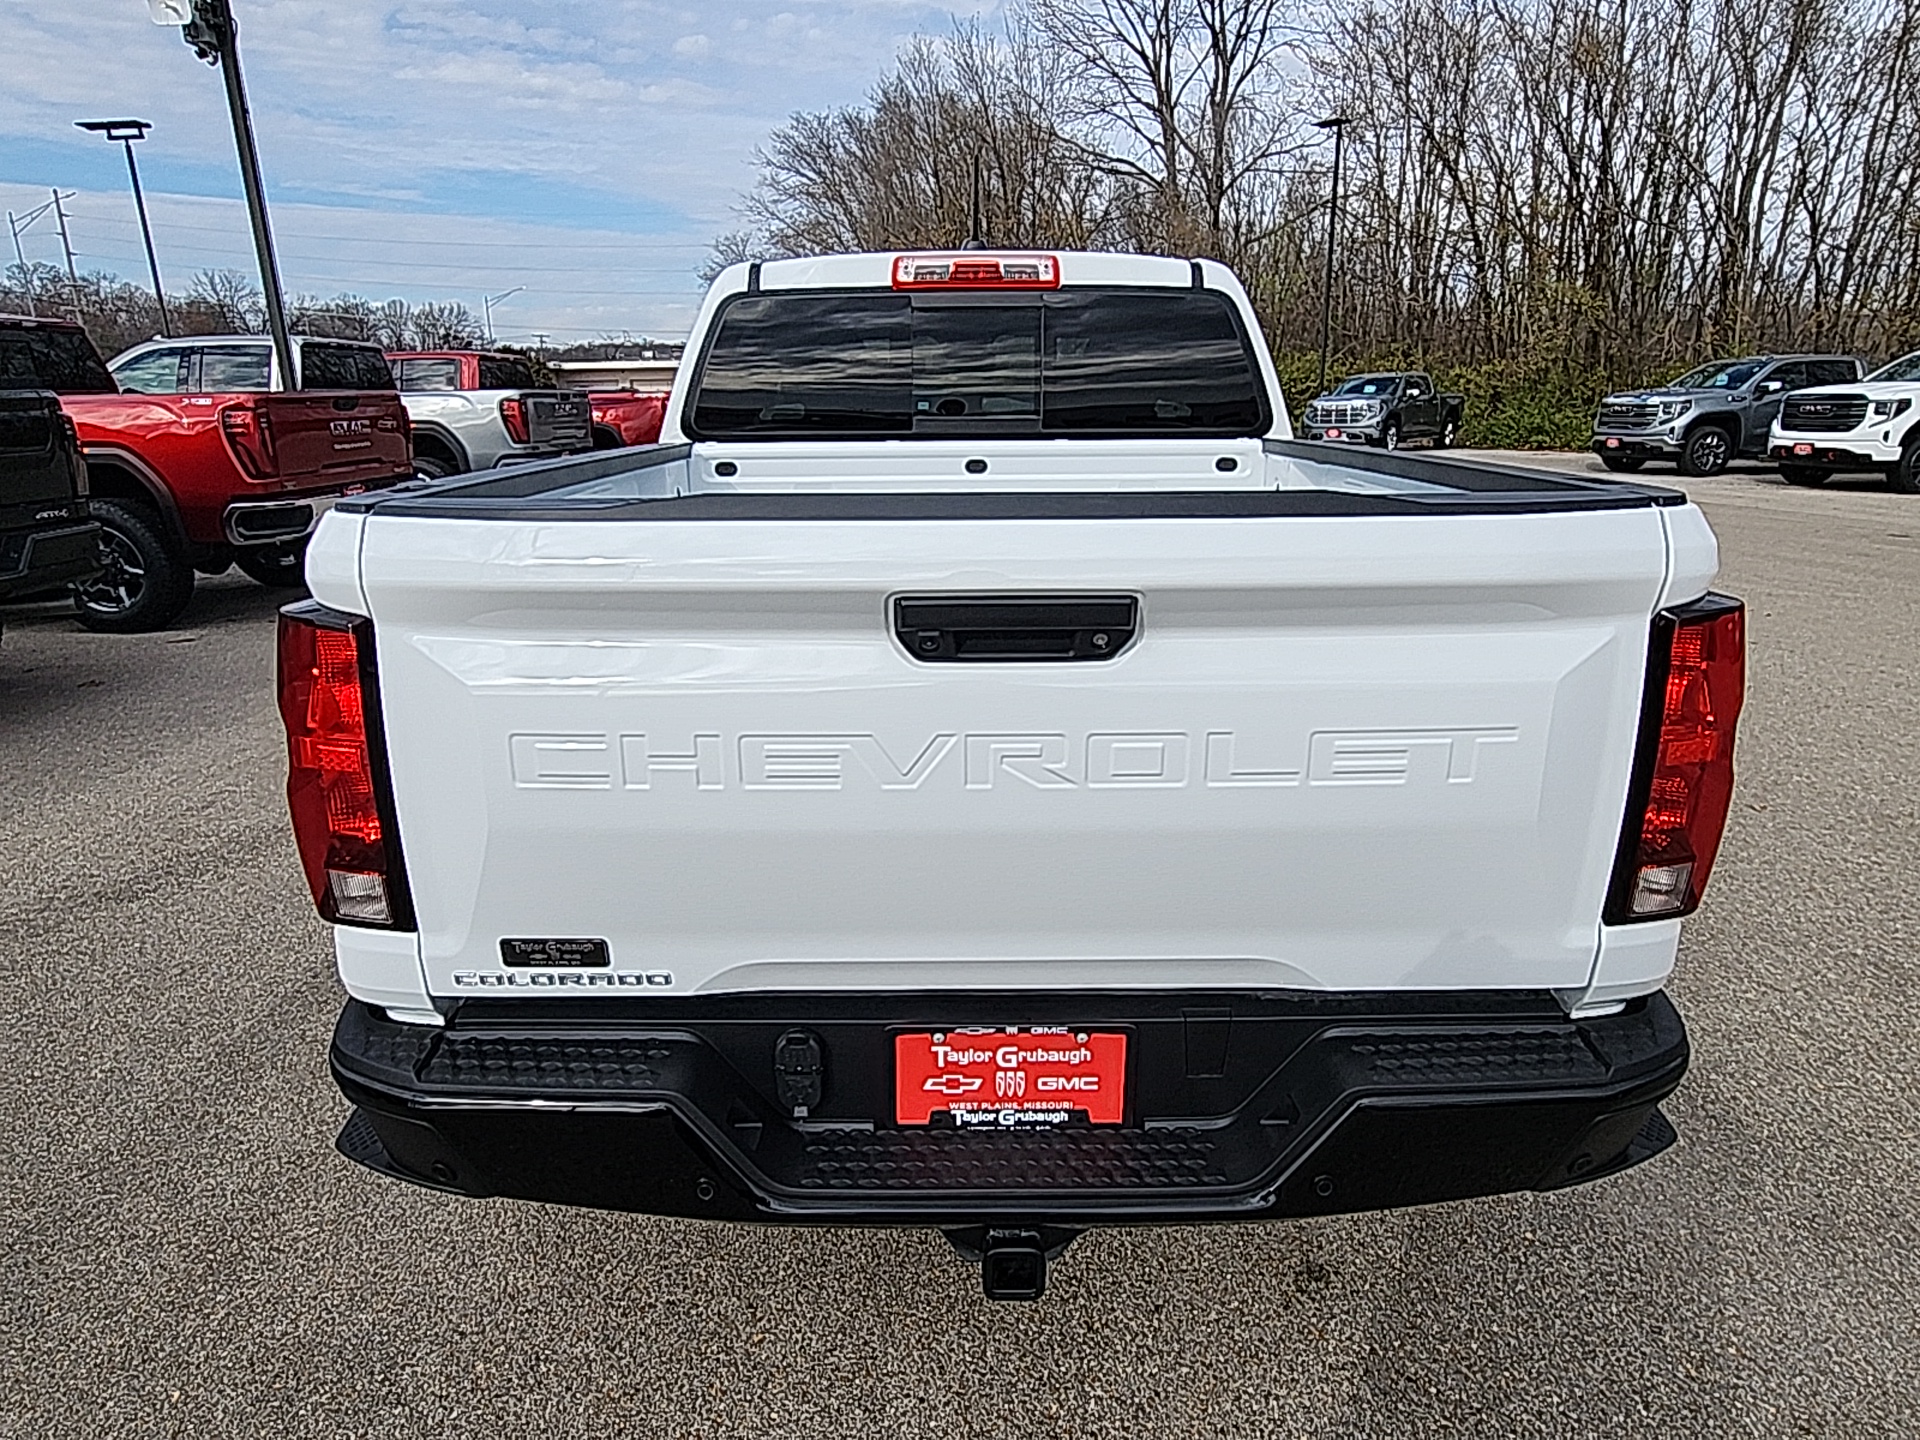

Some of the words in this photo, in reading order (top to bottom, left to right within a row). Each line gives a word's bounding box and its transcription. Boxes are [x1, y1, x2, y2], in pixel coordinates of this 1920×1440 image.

[508, 726, 1519, 790] CHEVROLET
[453, 971, 673, 986] COLORADO
[1031, 1026, 1069, 1035] GMC
[931, 1046, 993, 1067] Taylor
[996, 1046, 1091, 1067] Grubaugh
[1037, 1077, 1099, 1090] GMC
[949, 1102, 978, 1110] WEST
[1023, 1101, 1073, 1110] MISSOURI
[950, 1109, 996, 1126] Taylor
[998, 1109, 1069, 1125] Grubaugh
